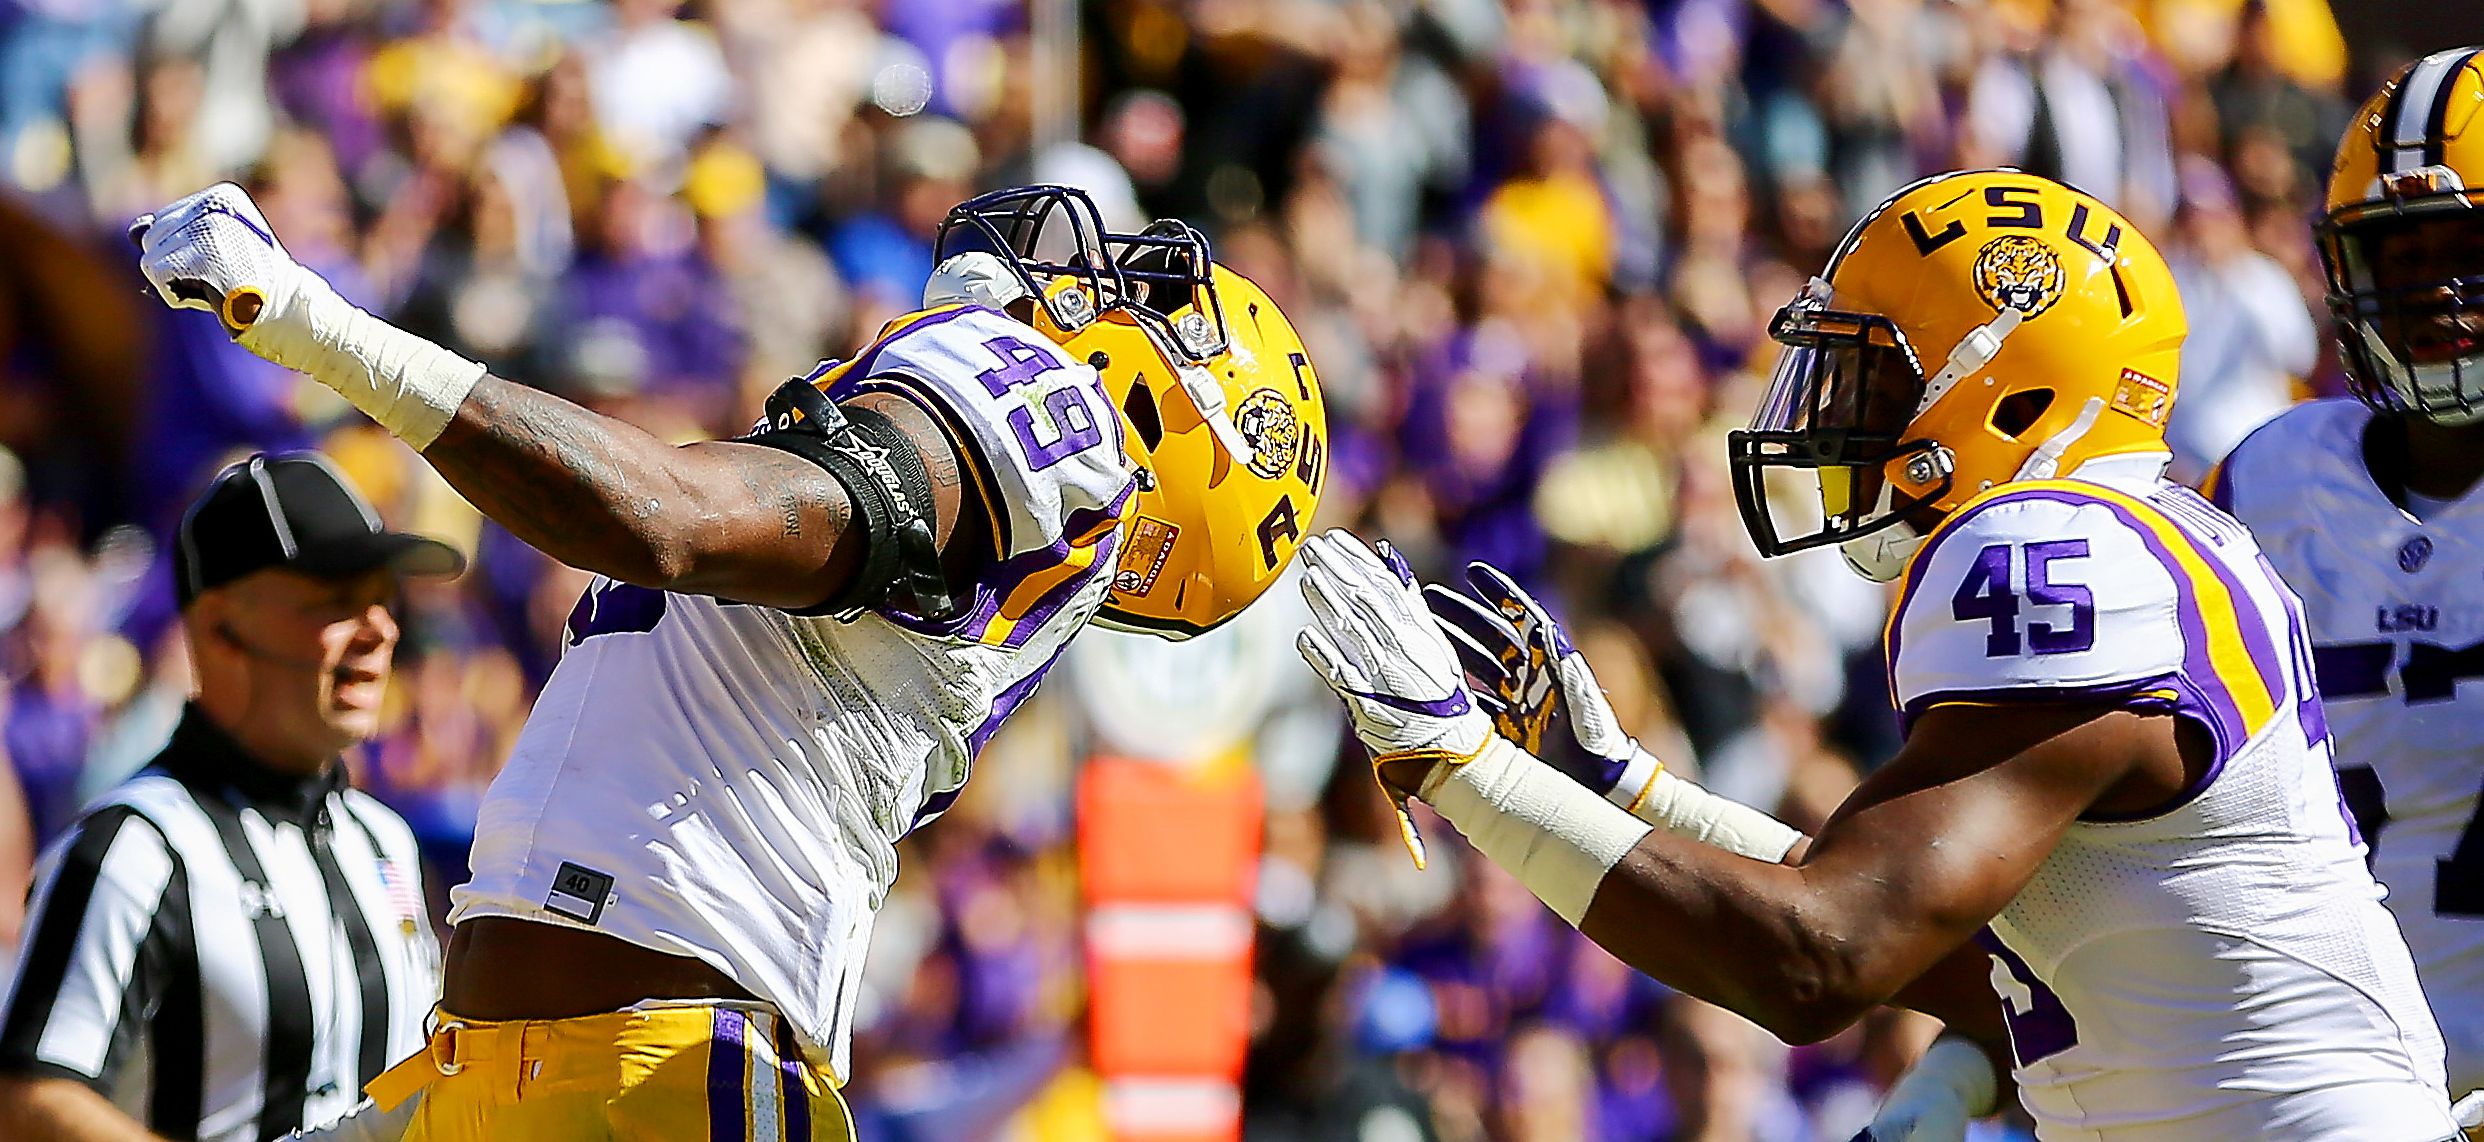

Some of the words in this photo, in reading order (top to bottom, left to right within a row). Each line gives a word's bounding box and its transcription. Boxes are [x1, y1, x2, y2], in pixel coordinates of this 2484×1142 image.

[1900, 187, 2121, 264] LSU
[975, 336, 1103, 473] 49
[858, 451, 910, 513] DOUGLAS
[1951, 538, 2095, 657] 45
[2377, 604, 2439, 633] LSU
[566, 874, 590, 893] 40
